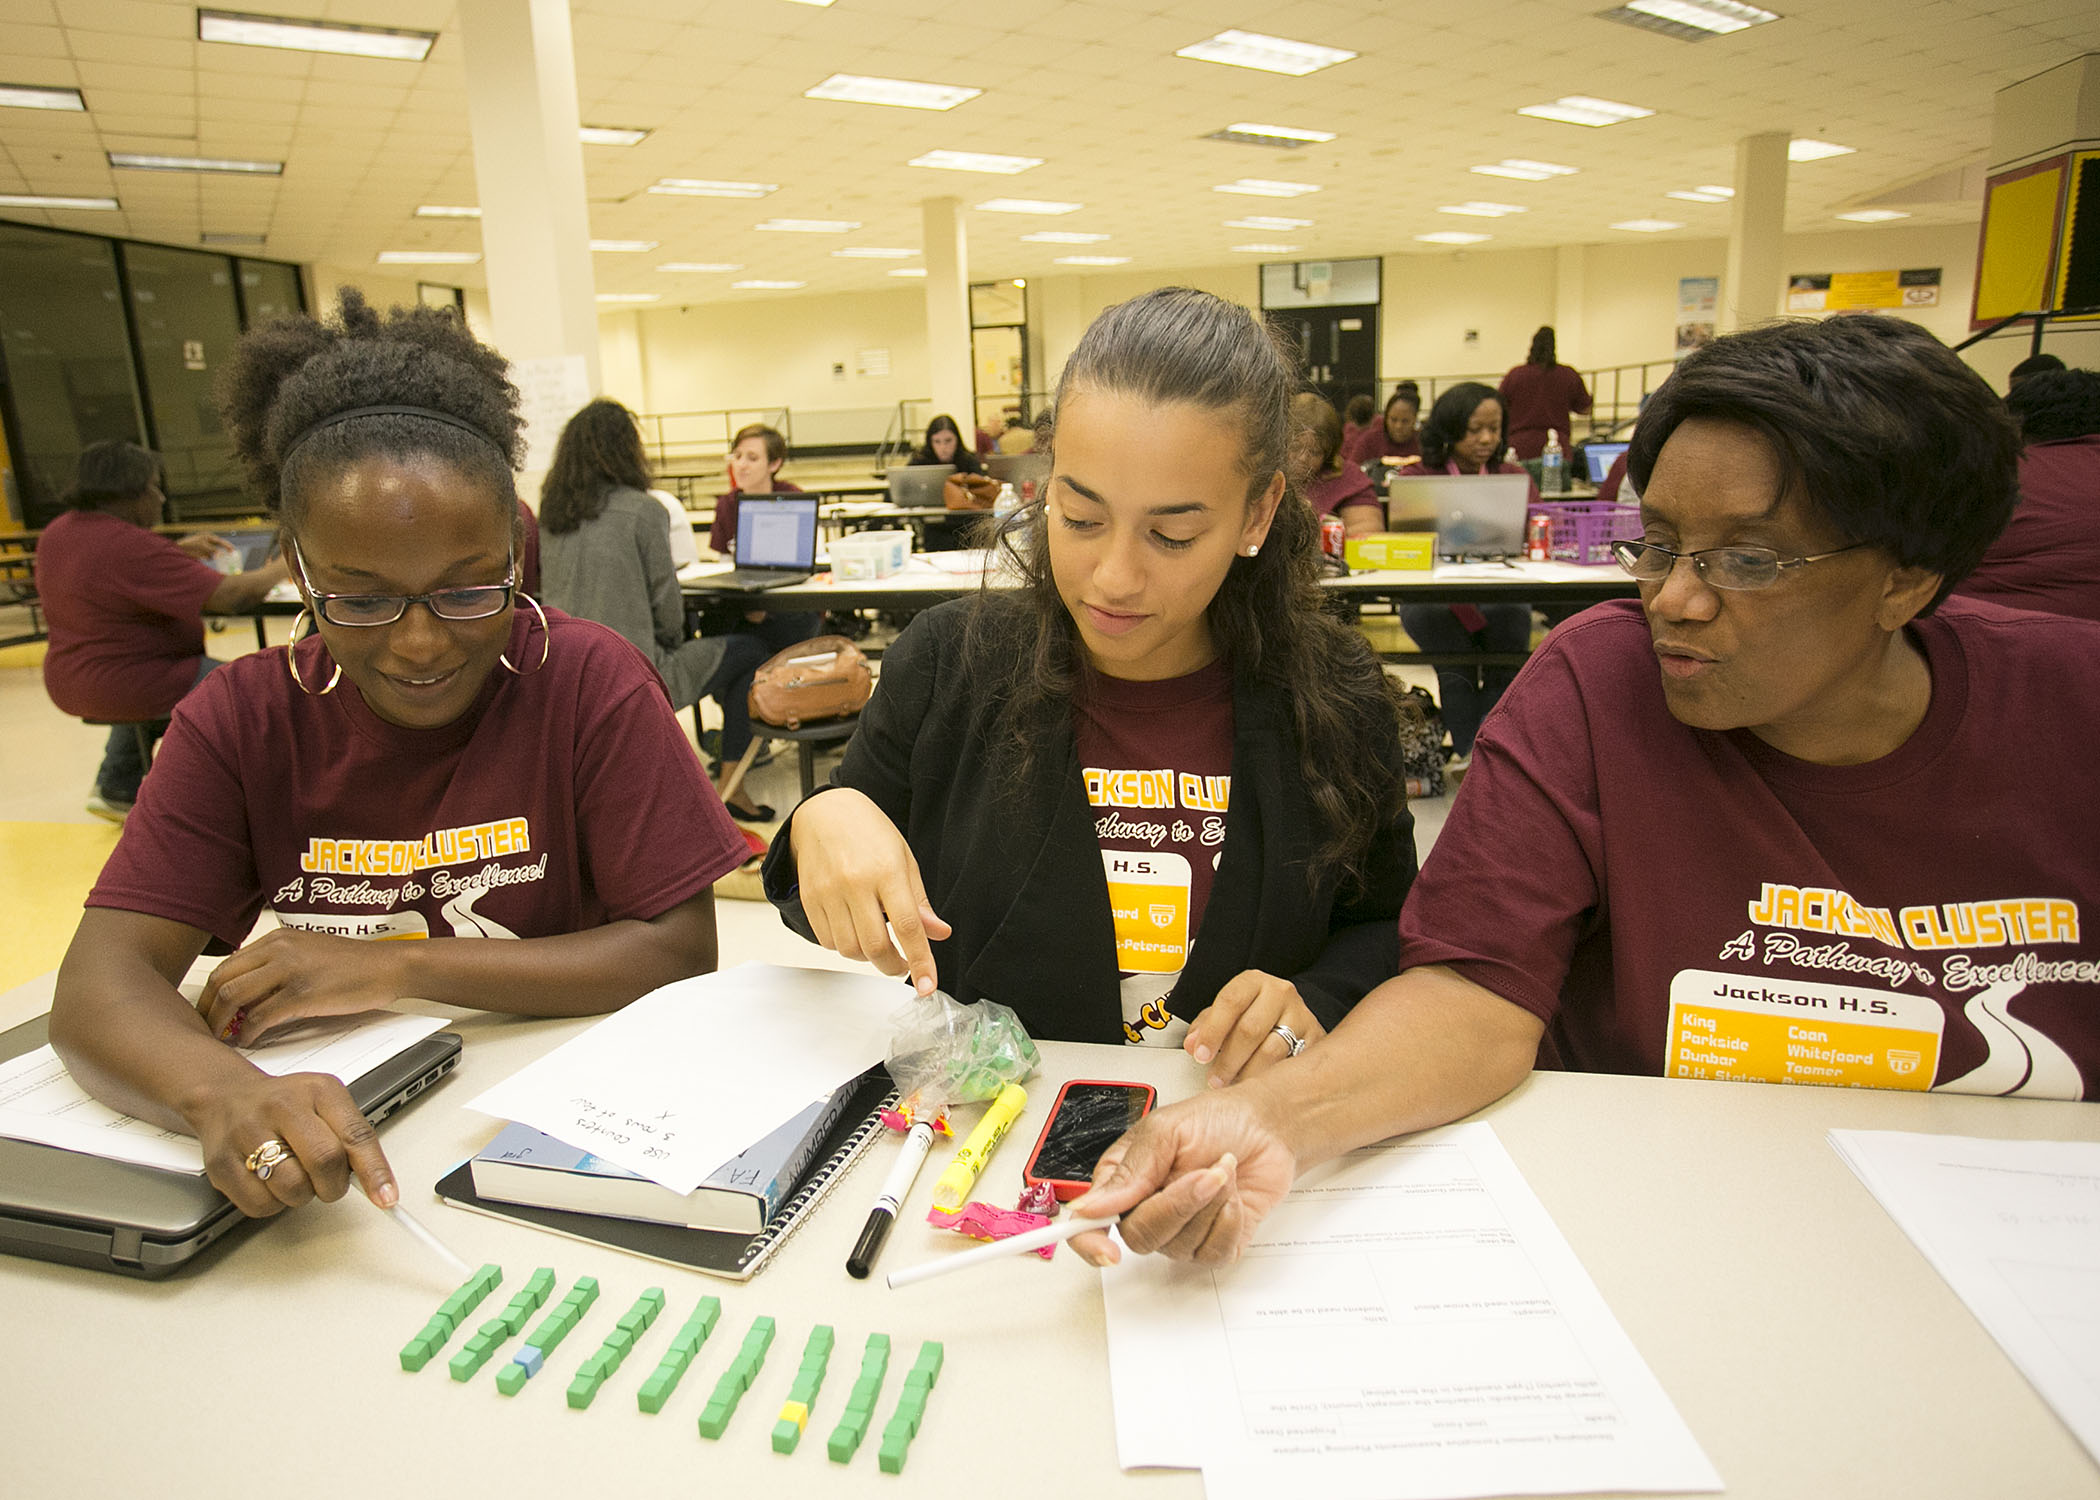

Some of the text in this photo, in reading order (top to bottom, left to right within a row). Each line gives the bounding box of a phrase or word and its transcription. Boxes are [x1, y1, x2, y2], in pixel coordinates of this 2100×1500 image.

[1082, 767, 1175, 809] CKSON
[1095, 811, 1168, 848] thway
[1171, 819, 1194, 842] to
[300, 837, 420, 876] JACKSON
[1113, 860, 1157, 874] H.S.
[273, 853, 547, 910] A Pathway to Excellence!
[356, 924, 396, 935] H.S.
[1899, 898, 2080, 951] CLUSTER
[1116, 938, 1183, 954] s-Peterson
[1719, 930, 1756, 961] A
[1763, 932, 1911, 987] Pathway
[1713, 984, 1898, 1016] Jackson H.S.
[1682, 1013, 1717, 1033] King
[1681, 1031, 1749, 1051] Parkside
[1788, 1025, 1828, 1043] Coan
[1680, 1048, 1737, 1067] Dunbar
[1787, 1044, 1874, 1065] Whitefoord
[1786, 1061, 1844, 1077] Toomer
